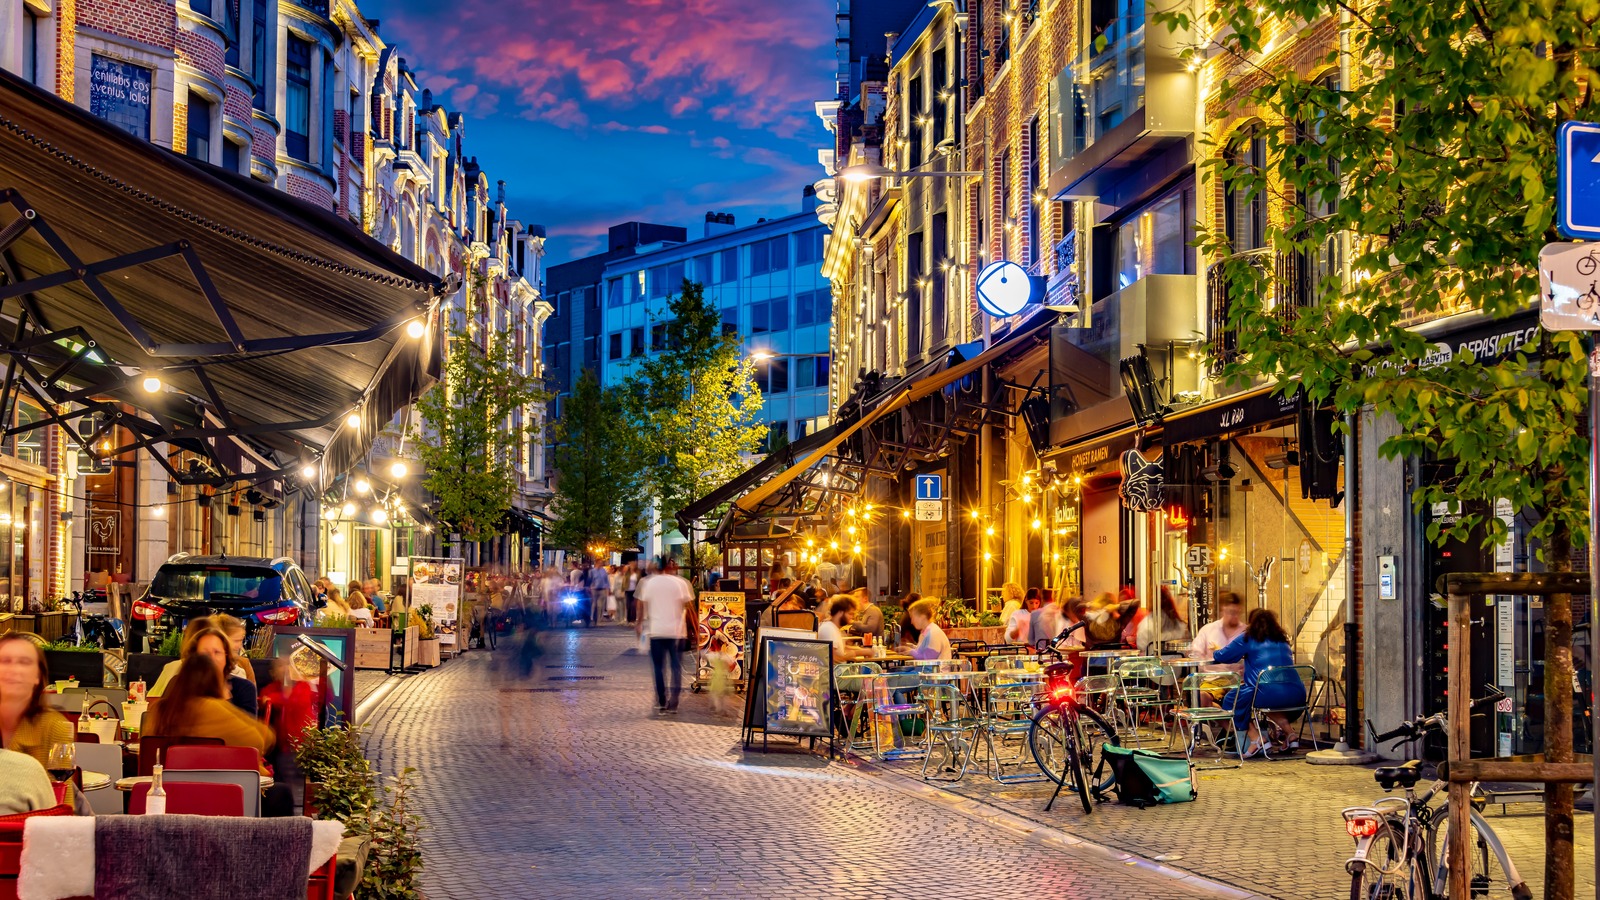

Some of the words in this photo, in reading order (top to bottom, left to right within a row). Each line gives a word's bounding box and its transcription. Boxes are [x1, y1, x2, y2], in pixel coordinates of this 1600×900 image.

[133, 81, 149, 92] eos
[1220, 411, 1230, 427] XL
[1071, 452, 1090, 468] HONEST
[1091, 446, 1109, 462] RAMEN
[1098, 535, 1107, 544] 18
